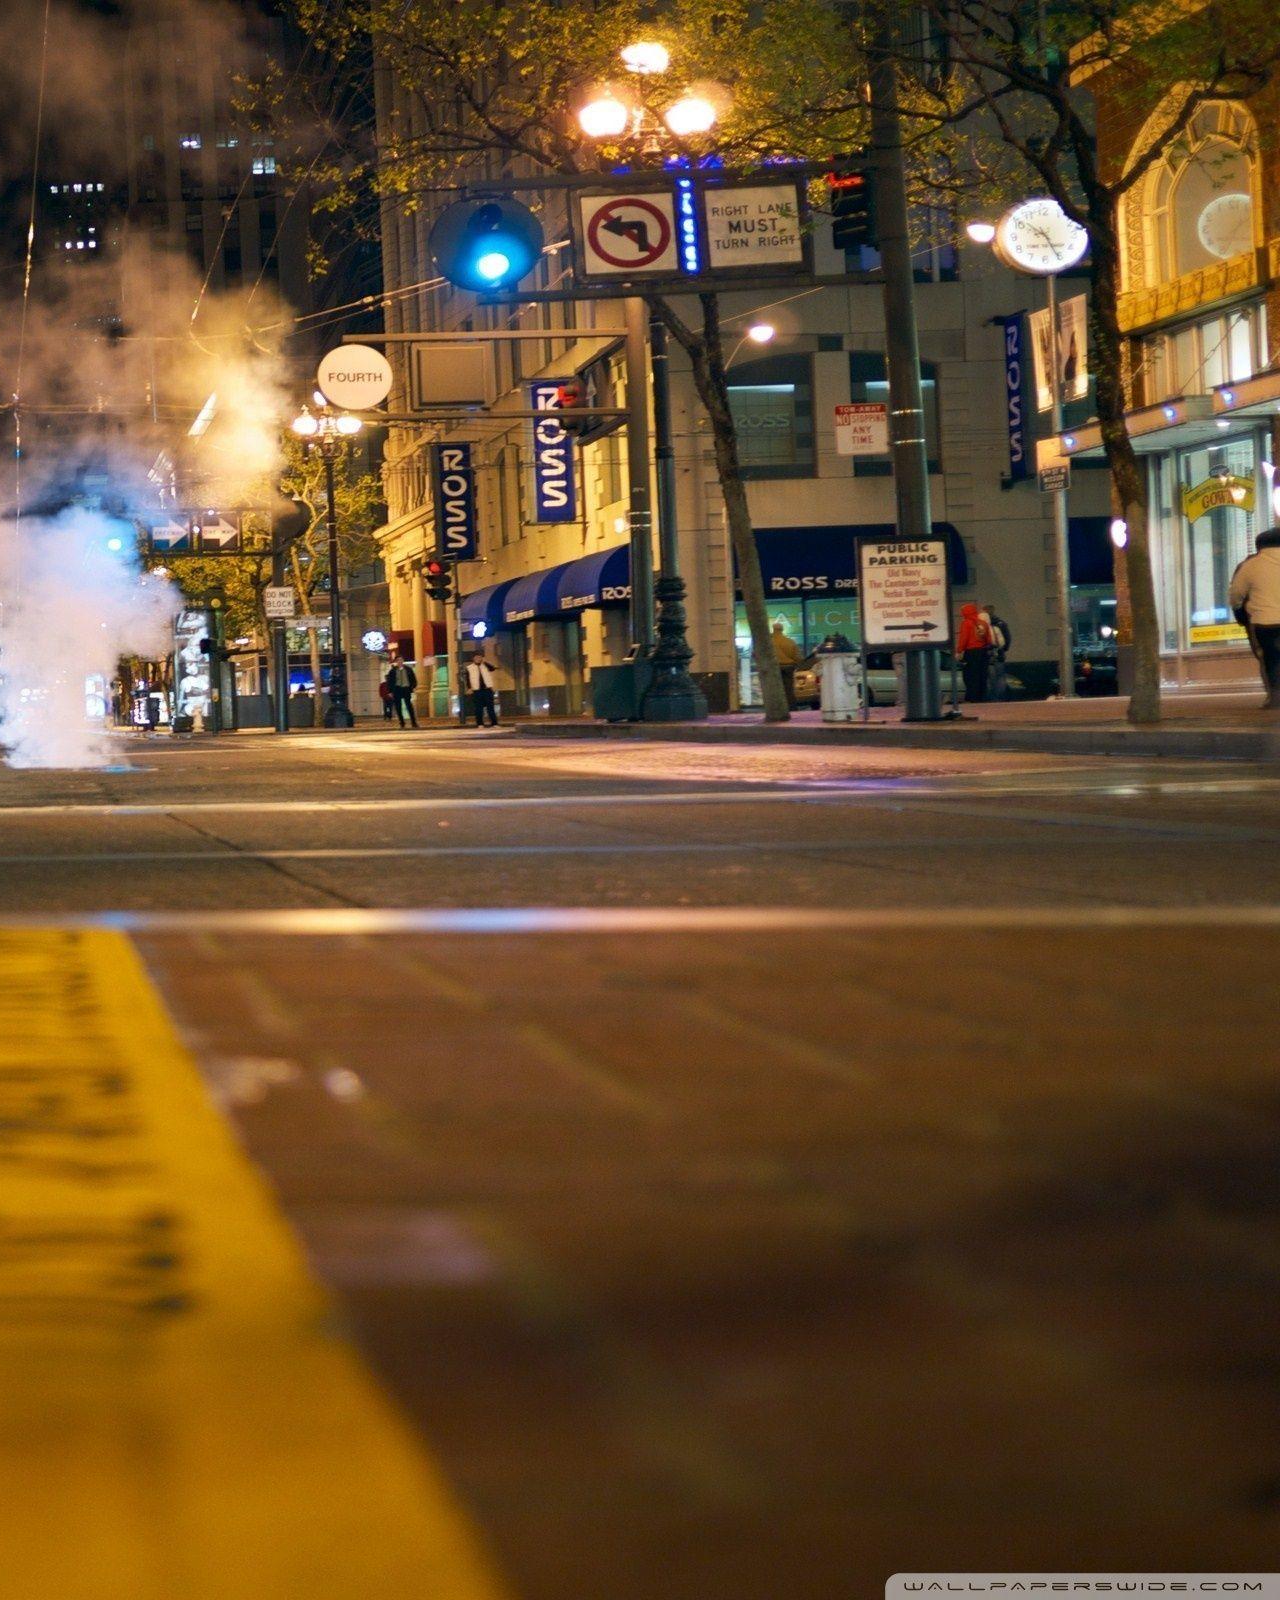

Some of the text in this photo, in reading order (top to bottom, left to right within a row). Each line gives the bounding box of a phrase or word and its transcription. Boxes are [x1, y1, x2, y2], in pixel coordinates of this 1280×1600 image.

[712, 202, 793, 216] RIGHT LANE
[728, 218, 779, 233] MUST
[715, 235, 796, 250] TURN RIGHT
[327, 372, 384, 383] FOURTH
[1007, 325, 1024, 463] ROSS
[836, 414, 850, 425] NO
[852, 426, 872, 434] ANY
[852, 435, 874, 445] TIME
[536, 387, 569, 508] ROSS
[441, 449, 469, 549] ROSS
[877, 543, 929, 554] PUBLIC
[869, 554, 938, 566] PARKING
[771, 576, 859, 590] ROSS DRE
[266, 591, 292, 599] DO NOT
[602, 585, 632, 600] ROS
